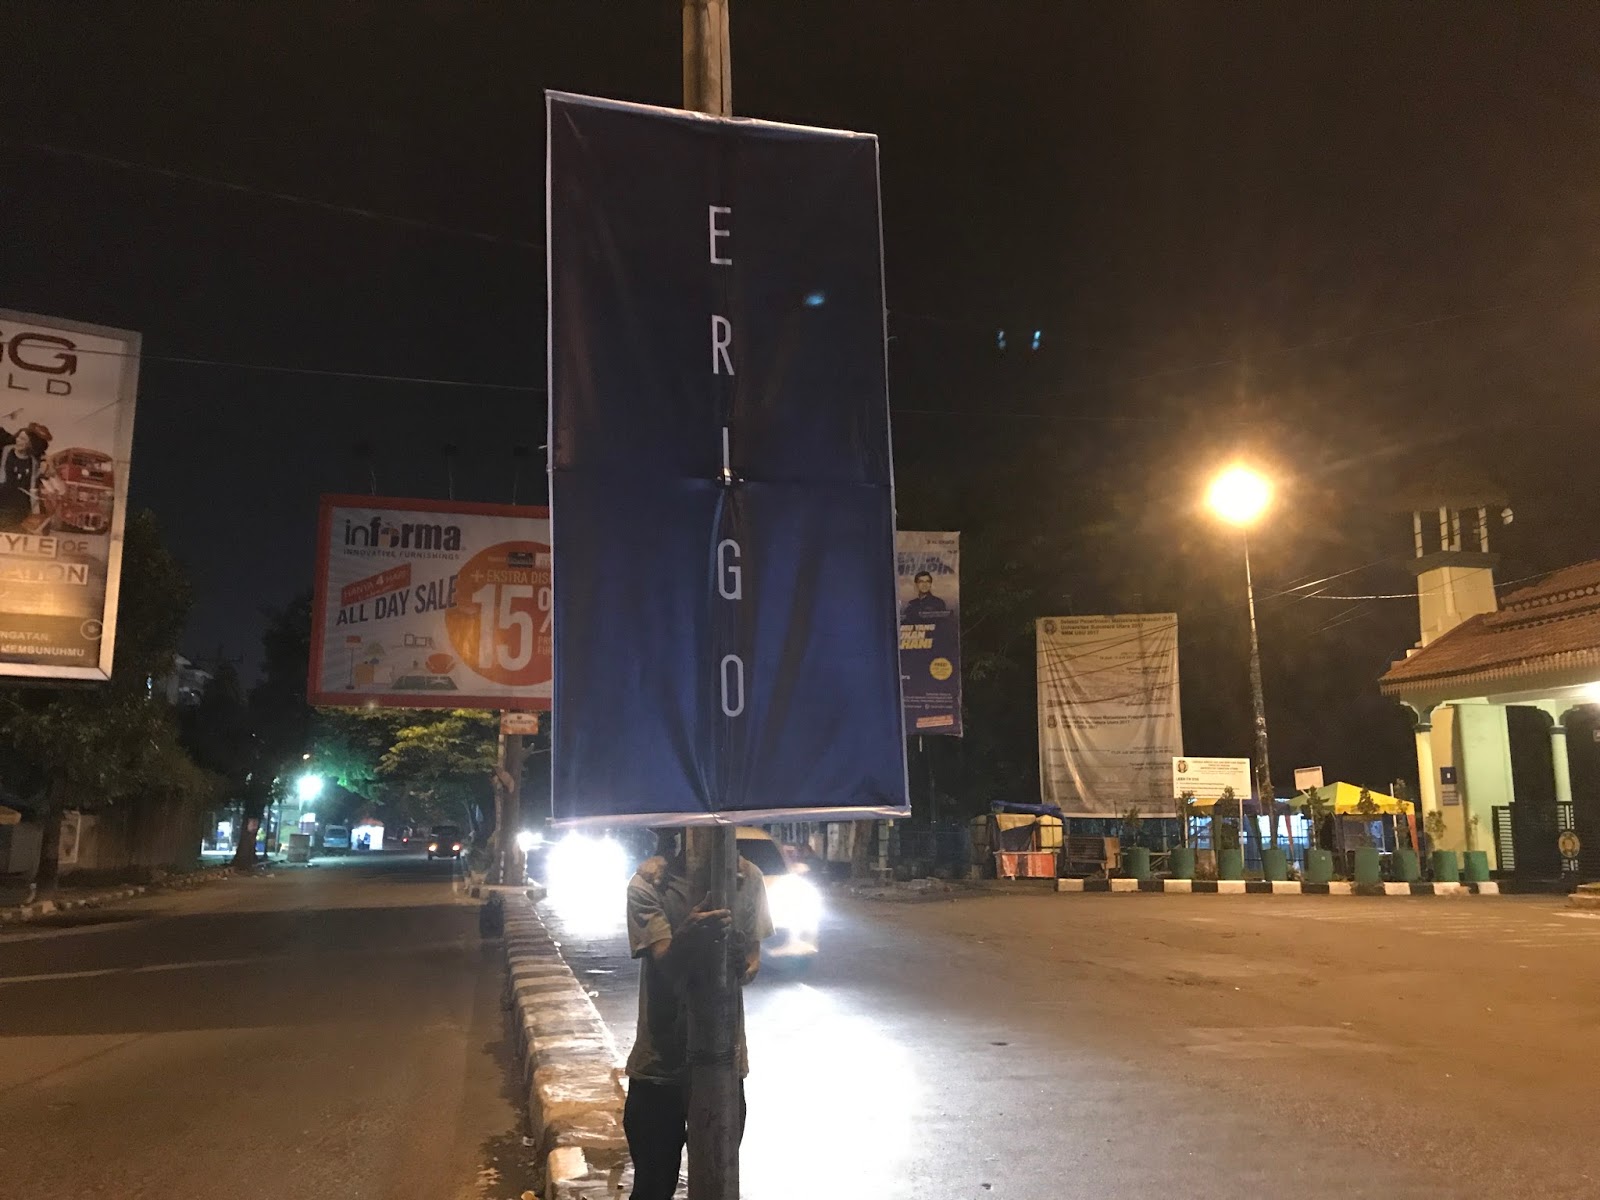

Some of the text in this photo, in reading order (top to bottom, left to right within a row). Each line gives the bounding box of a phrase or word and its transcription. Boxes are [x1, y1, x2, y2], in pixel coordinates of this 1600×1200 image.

[708, 205, 745, 718] ERIGO
[345, 517, 461, 551] informa
[62, 540, 88, 552] OF
[400, 551, 459, 560] FURNISHINGS
[487, 570, 527, 584] EKSTRA
[336, 604, 369, 626] ALL
[375, 590, 410, 620] DAY
[415, 574, 458, 614] SALE
[1, 645, 85, 656] MEMBUNUHMU
